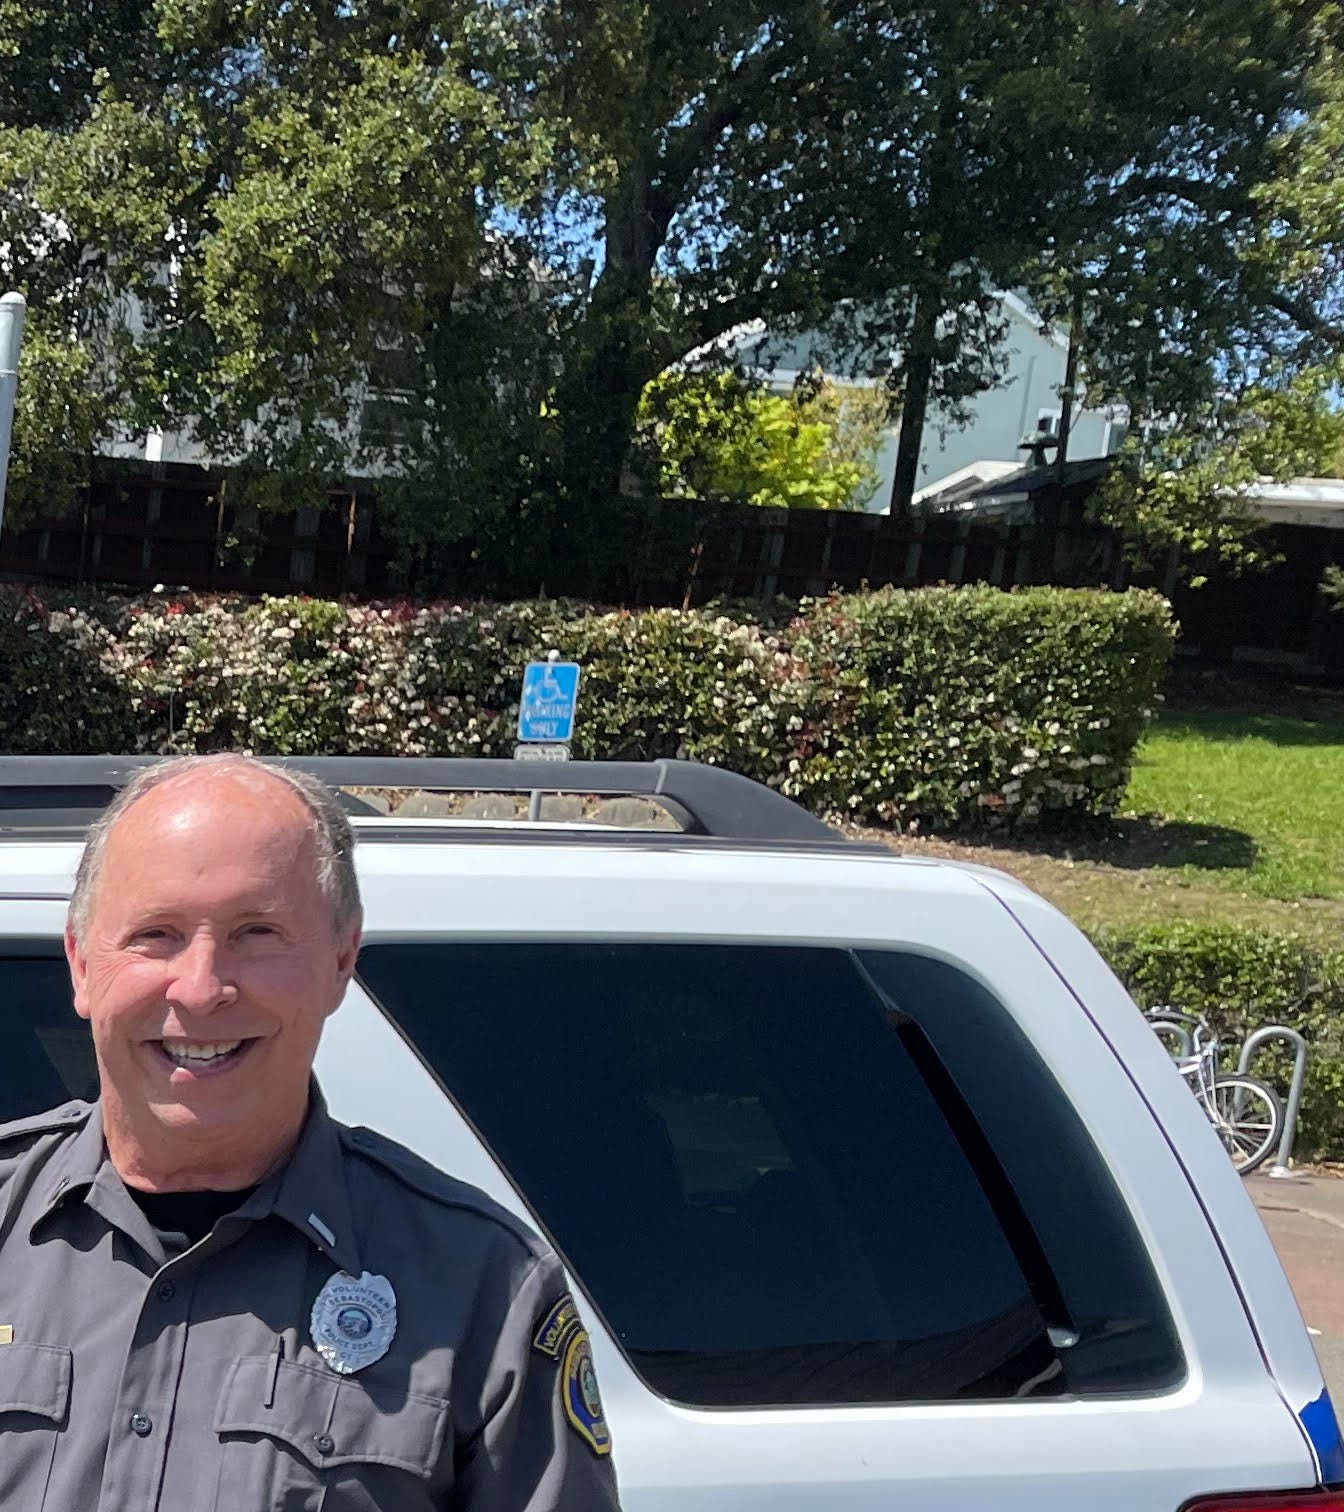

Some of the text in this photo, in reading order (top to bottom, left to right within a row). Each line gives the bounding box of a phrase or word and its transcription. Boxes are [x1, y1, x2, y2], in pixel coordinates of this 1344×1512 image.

[525, 703, 572, 719] KING
[328, 1295, 385, 1319] SEBASTOPOL
[331, 1286, 390, 1308] VOLUNTEER
